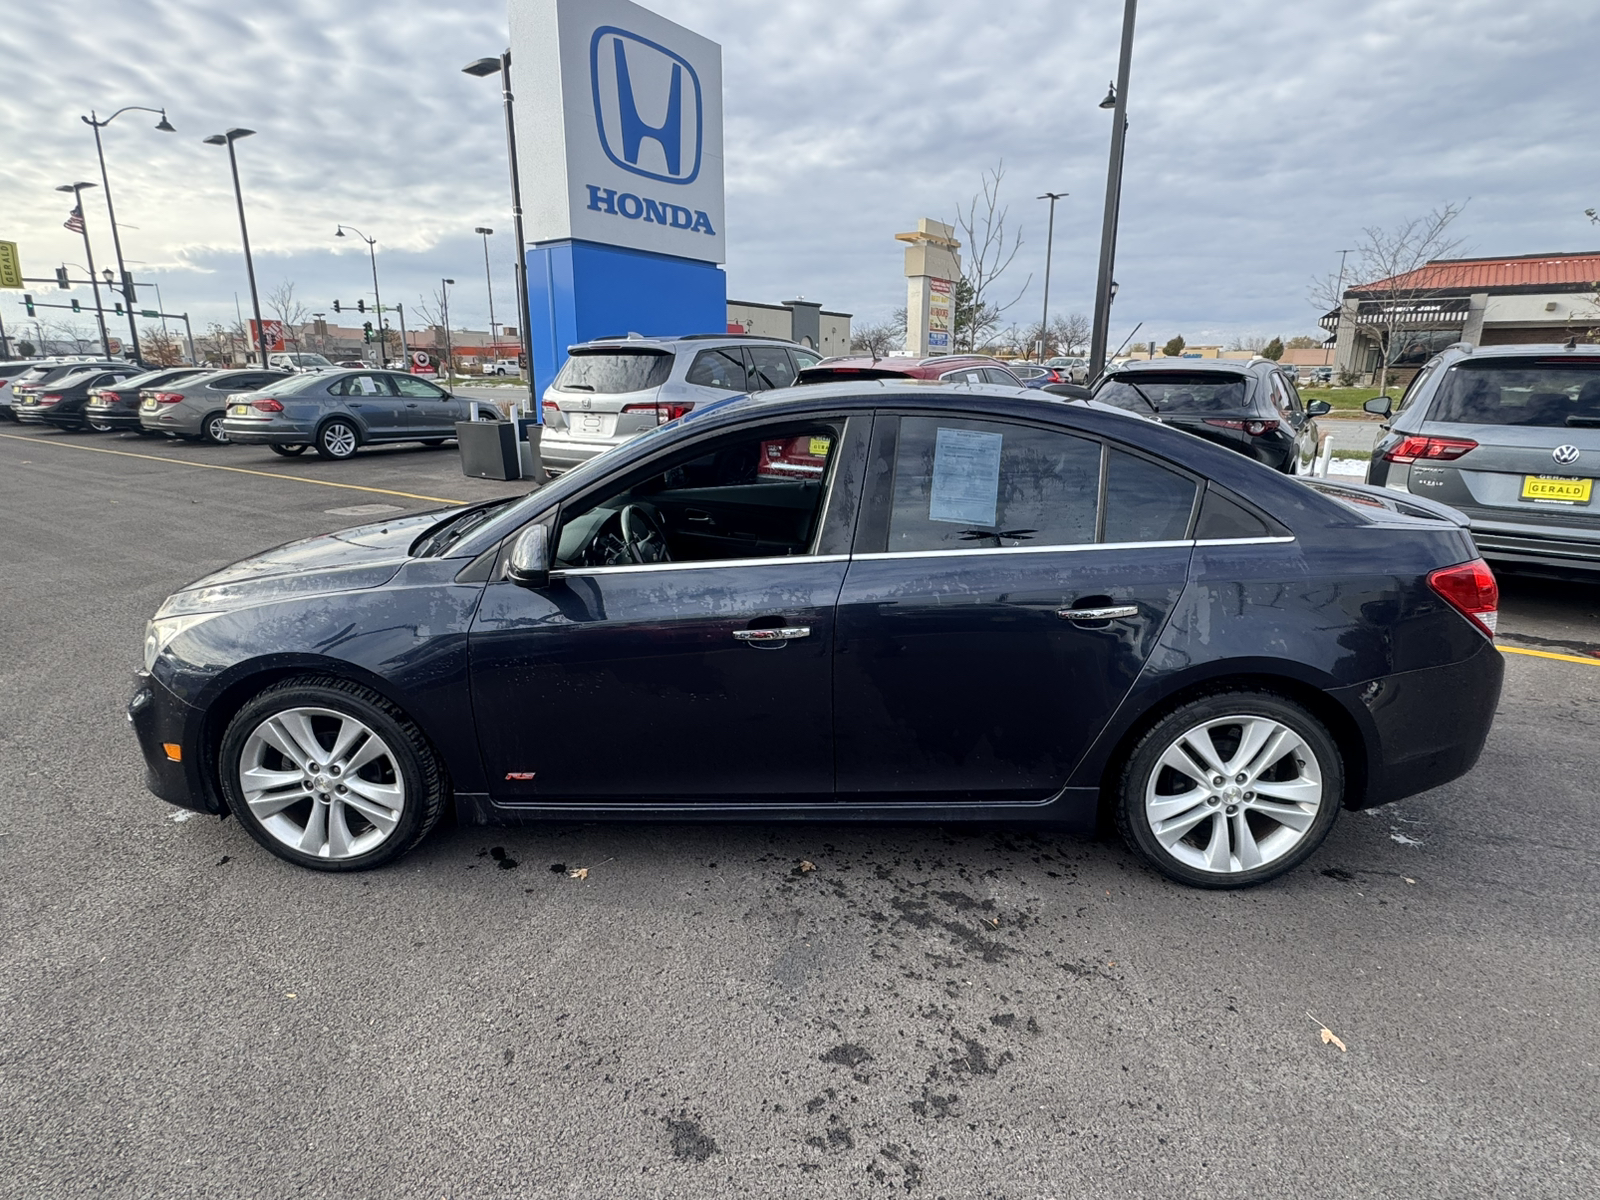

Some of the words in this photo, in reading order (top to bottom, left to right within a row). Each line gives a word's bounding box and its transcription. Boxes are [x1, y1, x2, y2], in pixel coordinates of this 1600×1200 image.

[586, 184, 716, 236] HONDA
[0, 245, 14, 283] GERALD
[1531, 484, 1581, 495] GERALD
